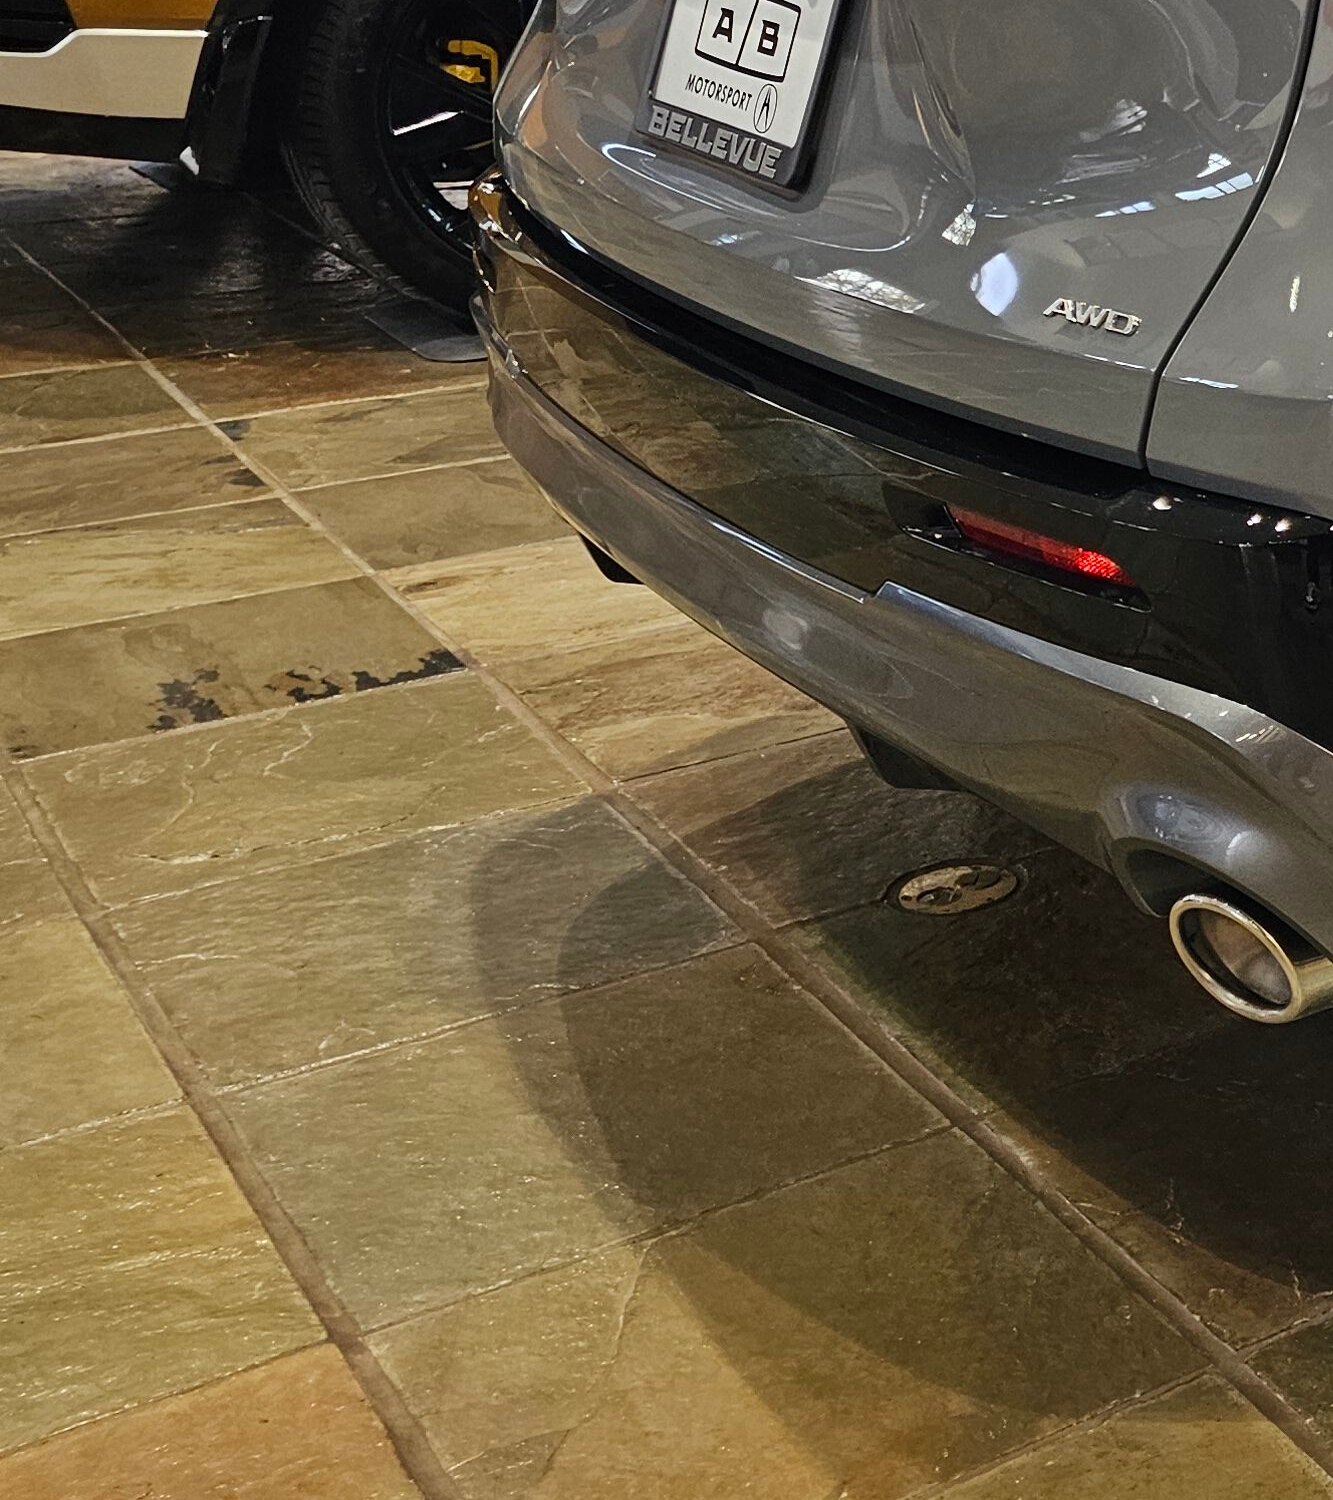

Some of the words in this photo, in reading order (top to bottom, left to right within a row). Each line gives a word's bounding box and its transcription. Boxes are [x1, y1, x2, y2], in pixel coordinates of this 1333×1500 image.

[712, 8, 735, 43] A
[757, 19, 780, 56] B
[684, 73, 752, 112] MOTORSPORT
[647, 105, 782, 179] BELLEVUE
[1043, 297, 1142, 335] AWD
